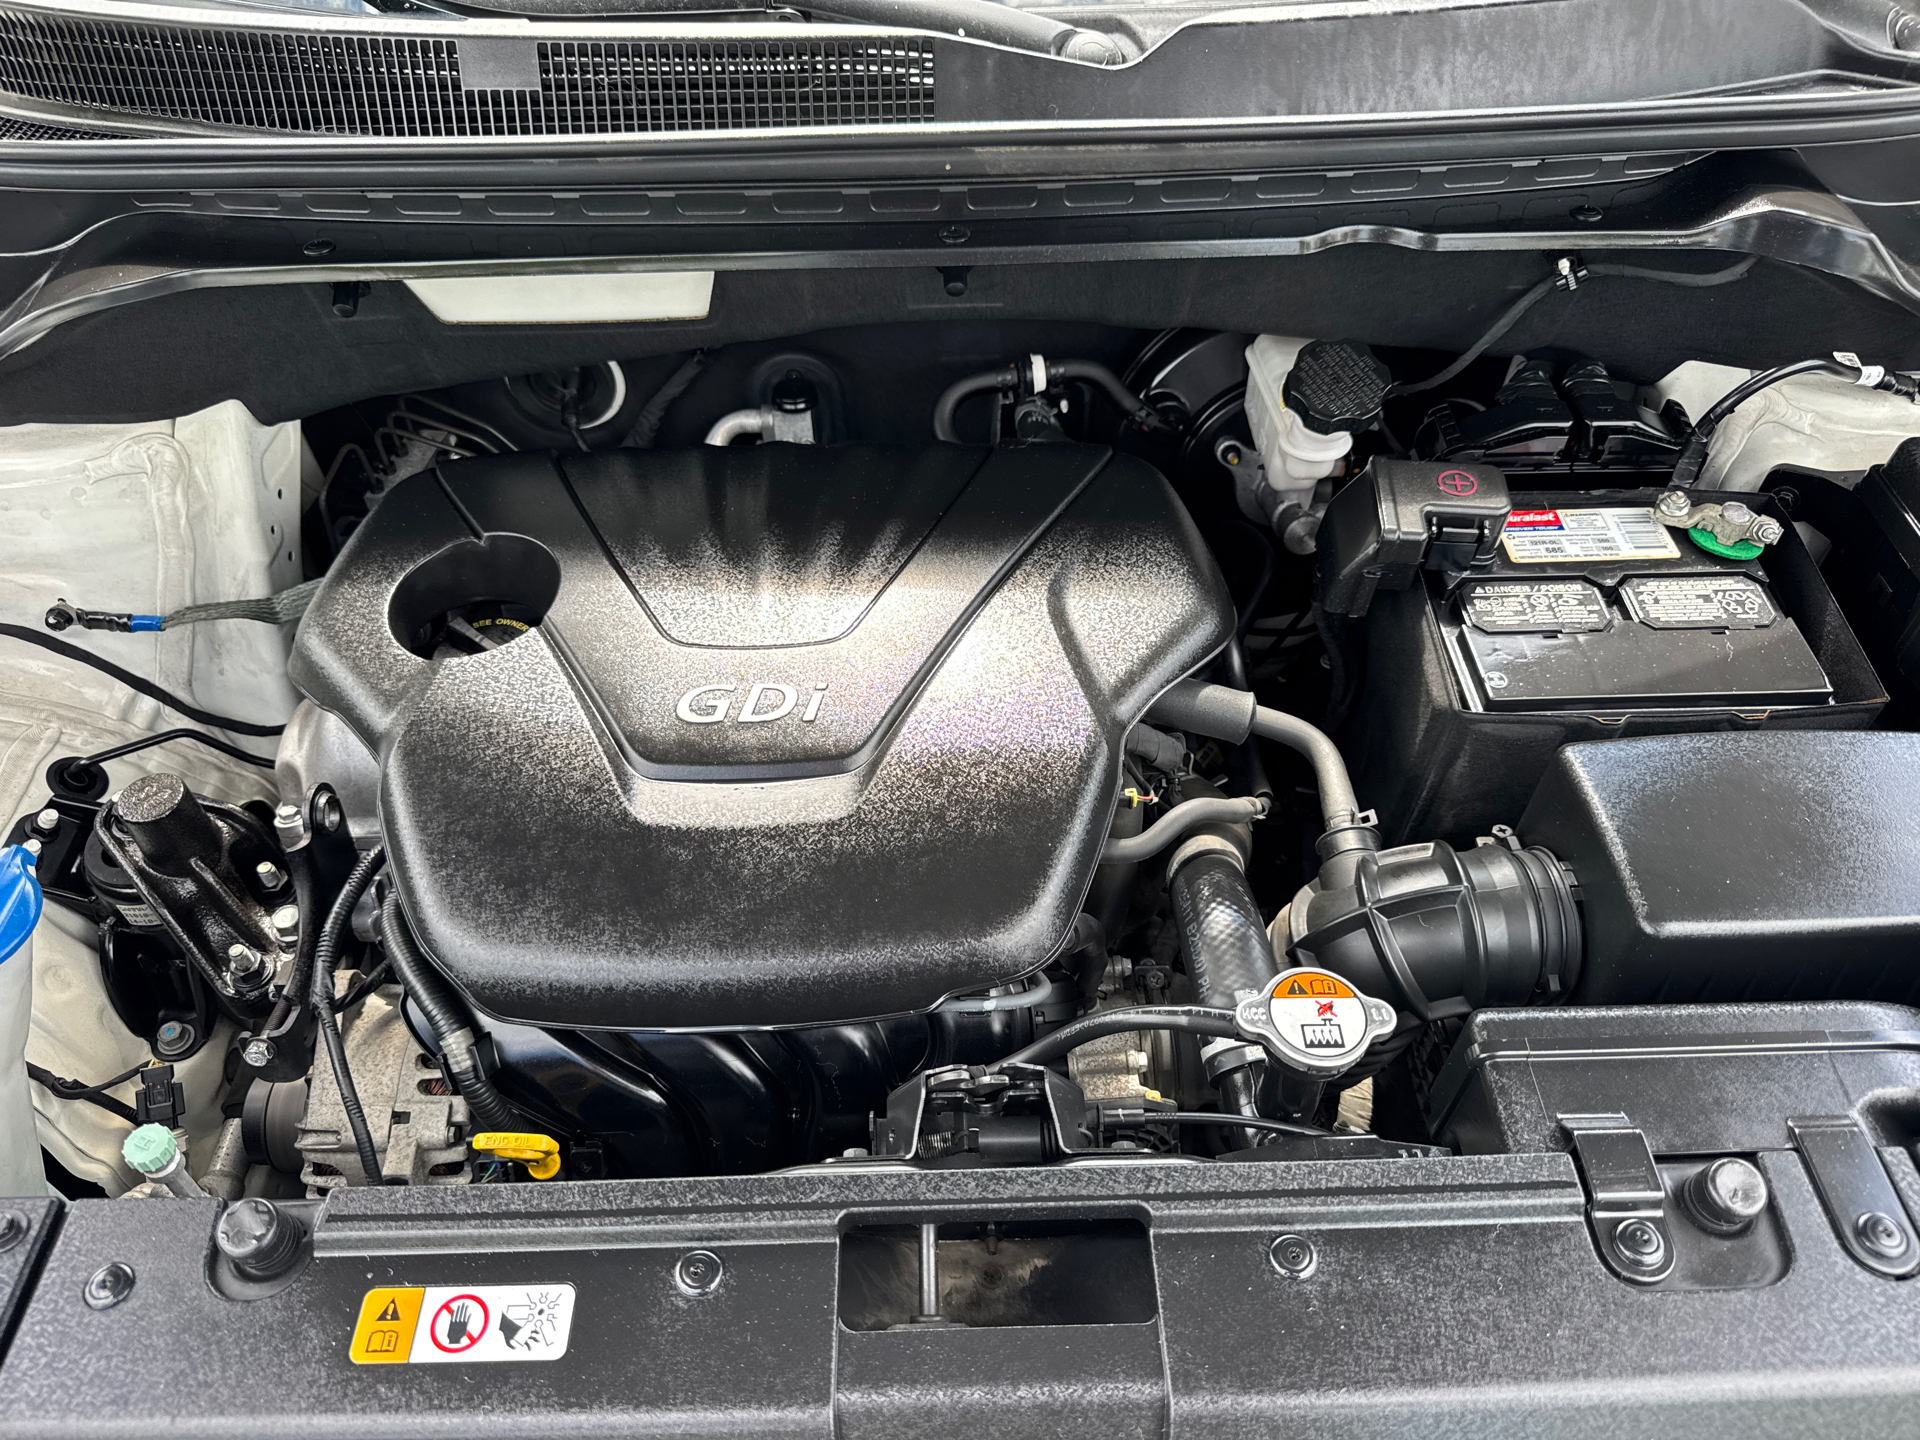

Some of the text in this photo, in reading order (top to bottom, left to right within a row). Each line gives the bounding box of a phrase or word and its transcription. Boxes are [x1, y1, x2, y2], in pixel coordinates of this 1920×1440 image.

[1507, 513, 1556, 523] uralast
[1485, 585, 1532, 594] DANGER
[1540, 584, 1583, 593] POISON
[472, 618, 530, 632] SEE OWNER
[674, 682, 829, 724] GDi
[484, 1134, 533, 1147] ENG OIL
